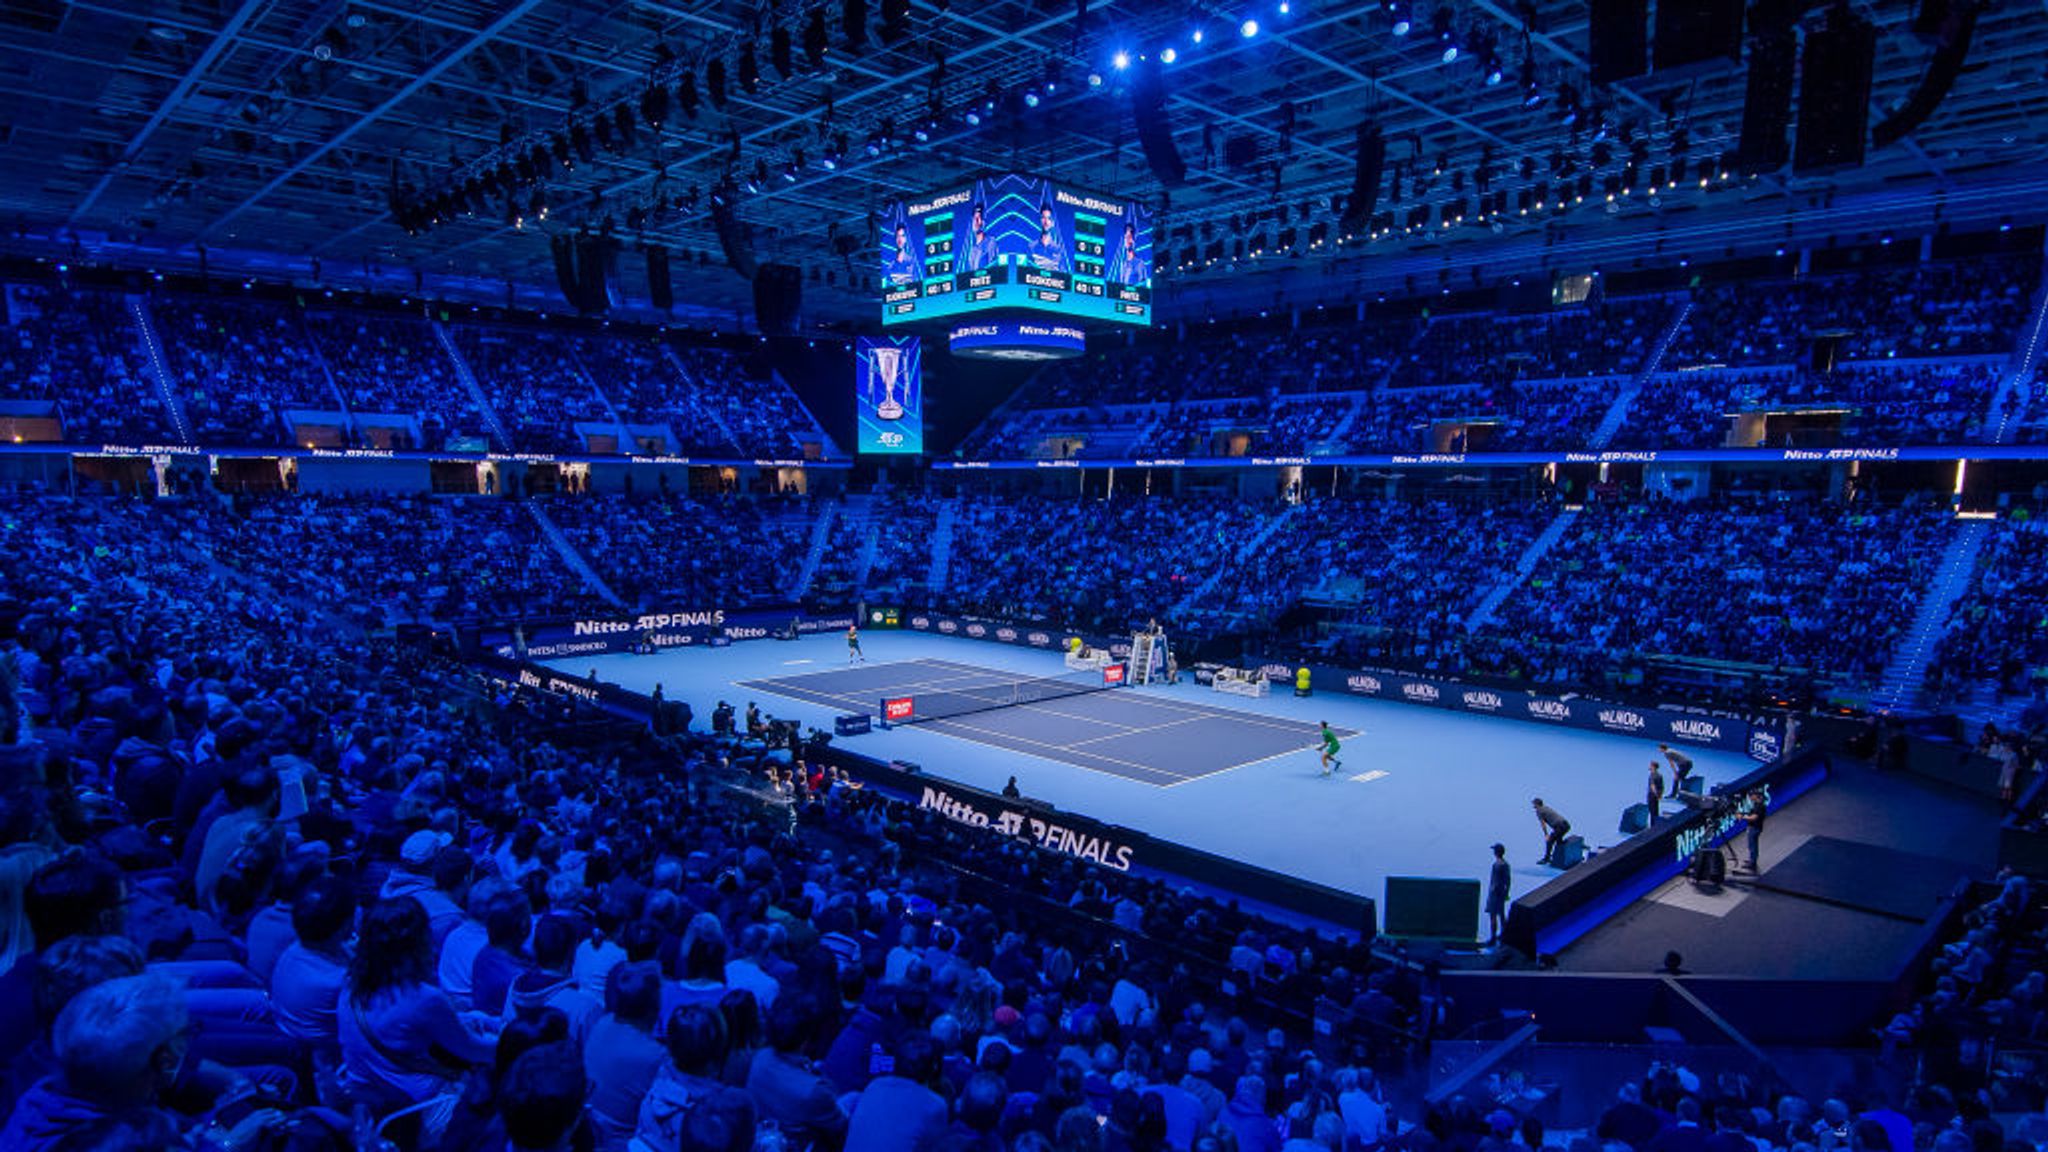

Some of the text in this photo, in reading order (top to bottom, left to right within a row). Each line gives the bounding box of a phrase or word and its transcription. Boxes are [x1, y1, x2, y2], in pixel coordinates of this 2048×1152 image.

[1783, 449, 1823, 459] Nitto
[574, 621, 631, 636] Nitto
[724, 626, 767, 639] Nitto
[1462, 691, 1502, 708] VALMORA
[1527, 700, 1571, 717] VALMORA
[1599, 709, 1645, 728] VALMORA
[1670, 719, 1721, 739] VALMORA
[917, 786, 990, 828] Nitto
[1043, 825, 1133, 872] FINALS
